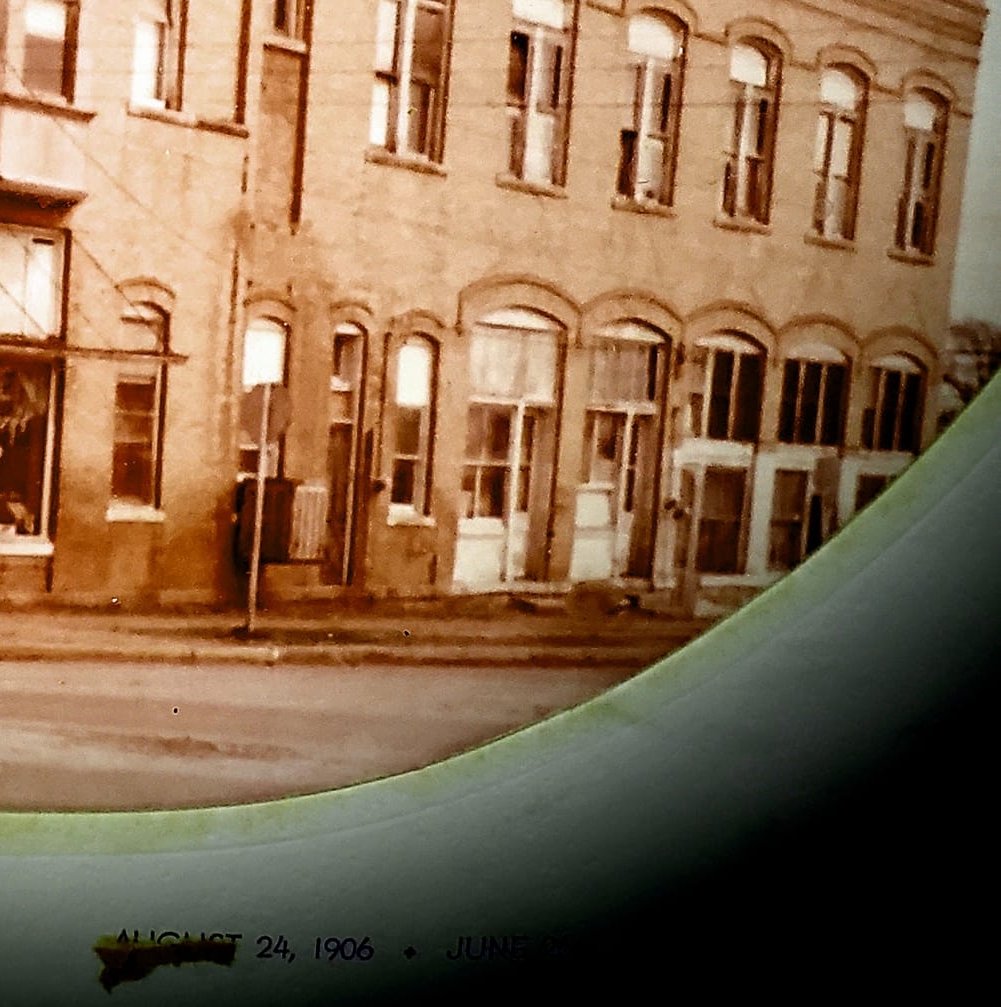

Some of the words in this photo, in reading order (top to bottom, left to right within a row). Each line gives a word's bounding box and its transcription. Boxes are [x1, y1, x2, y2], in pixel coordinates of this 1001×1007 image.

[255, 935, 297, 963] 24,
[315, 936, 376, 962] 1906
[445, 935, 529, 961] JUNE
